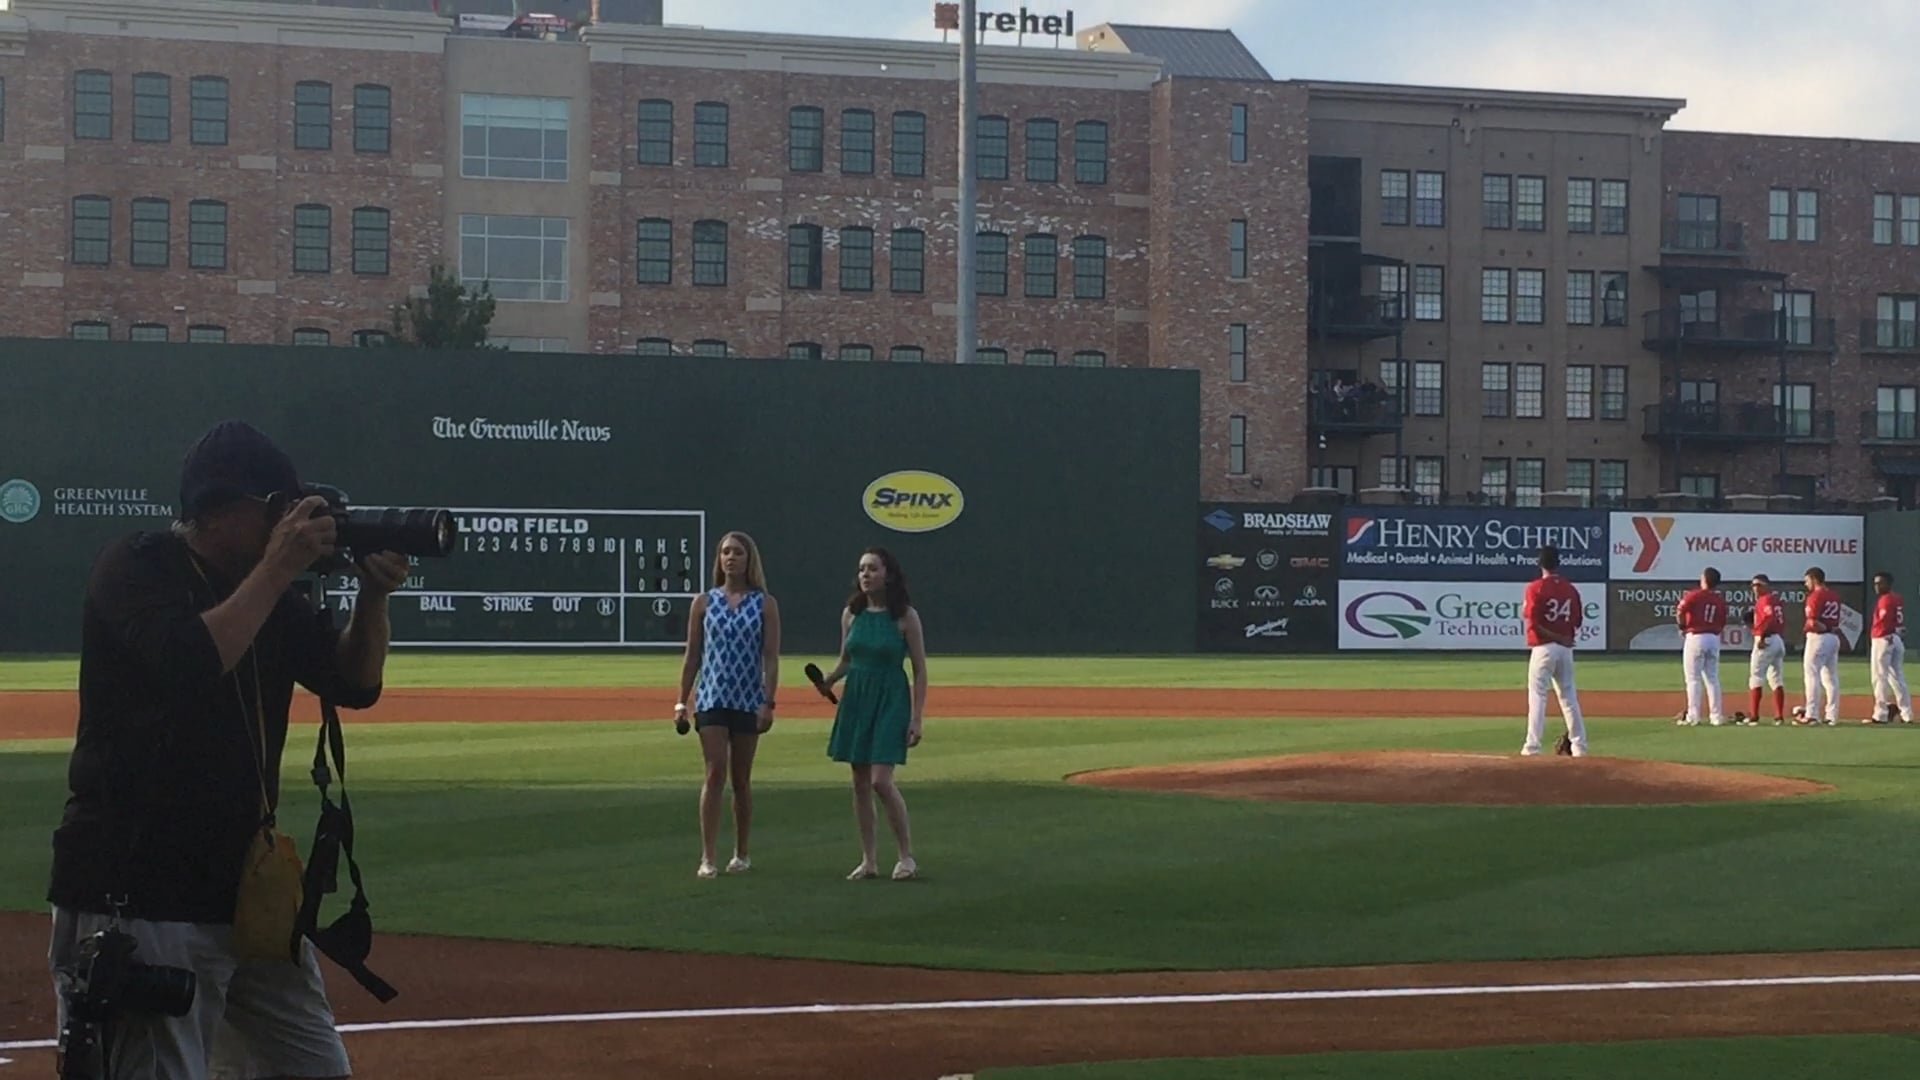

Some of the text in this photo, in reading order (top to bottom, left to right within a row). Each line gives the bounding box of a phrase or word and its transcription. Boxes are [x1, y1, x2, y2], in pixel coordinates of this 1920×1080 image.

[978, 7, 1074, 36] rehel
[432, 416, 611, 442] The Greenville News
[54, 488, 148, 501] GREENVILLE
[54, 503, 173, 516] HEALTH SYSTEM
[454, 517, 589, 533] LUOR FIELD
[1243, 513, 1332, 528] BRADSHAW
[1377, 518, 1480, 548] HENRY
[478, 537, 486, 552] 2
[492, 537, 500, 552] 3
[510, 537, 518, 552] 4
[525, 537, 533, 553] 5
[540, 537, 548, 553] 6
[559, 537, 567, 553] 7
[572, 537, 581, 553] 8
[587, 537, 595, 553] 9
[604, 537, 616, 553] 10
[635, 539, 643, 553] R
[657, 539, 666, 553] H
[680, 539, 688, 554] E
[1613, 542, 1634, 555] the
[1685, 536, 1857, 554] YMCA OF GREENVILLE
[1347, 551, 1388, 564] Medical
[1396, 552, 1429, 564] Dental
[1437, 552, 1473, 565] Animal
[1476, 553, 1508, 565] Health
[1516, 554, 1540, 565] Prac
[340, 576, 359, 590] 34
[420, 597, 456, 611] BALL
[483, 597, 534, 612] STRIKE
[552, 597, 581, 612] OUT
[1544, 599, 1572, 622] 34
[1822, 601, 1839, 620] 22
[1704, 604, 1717, 623] 11
[1436, 620, 1525, 636] Technical
